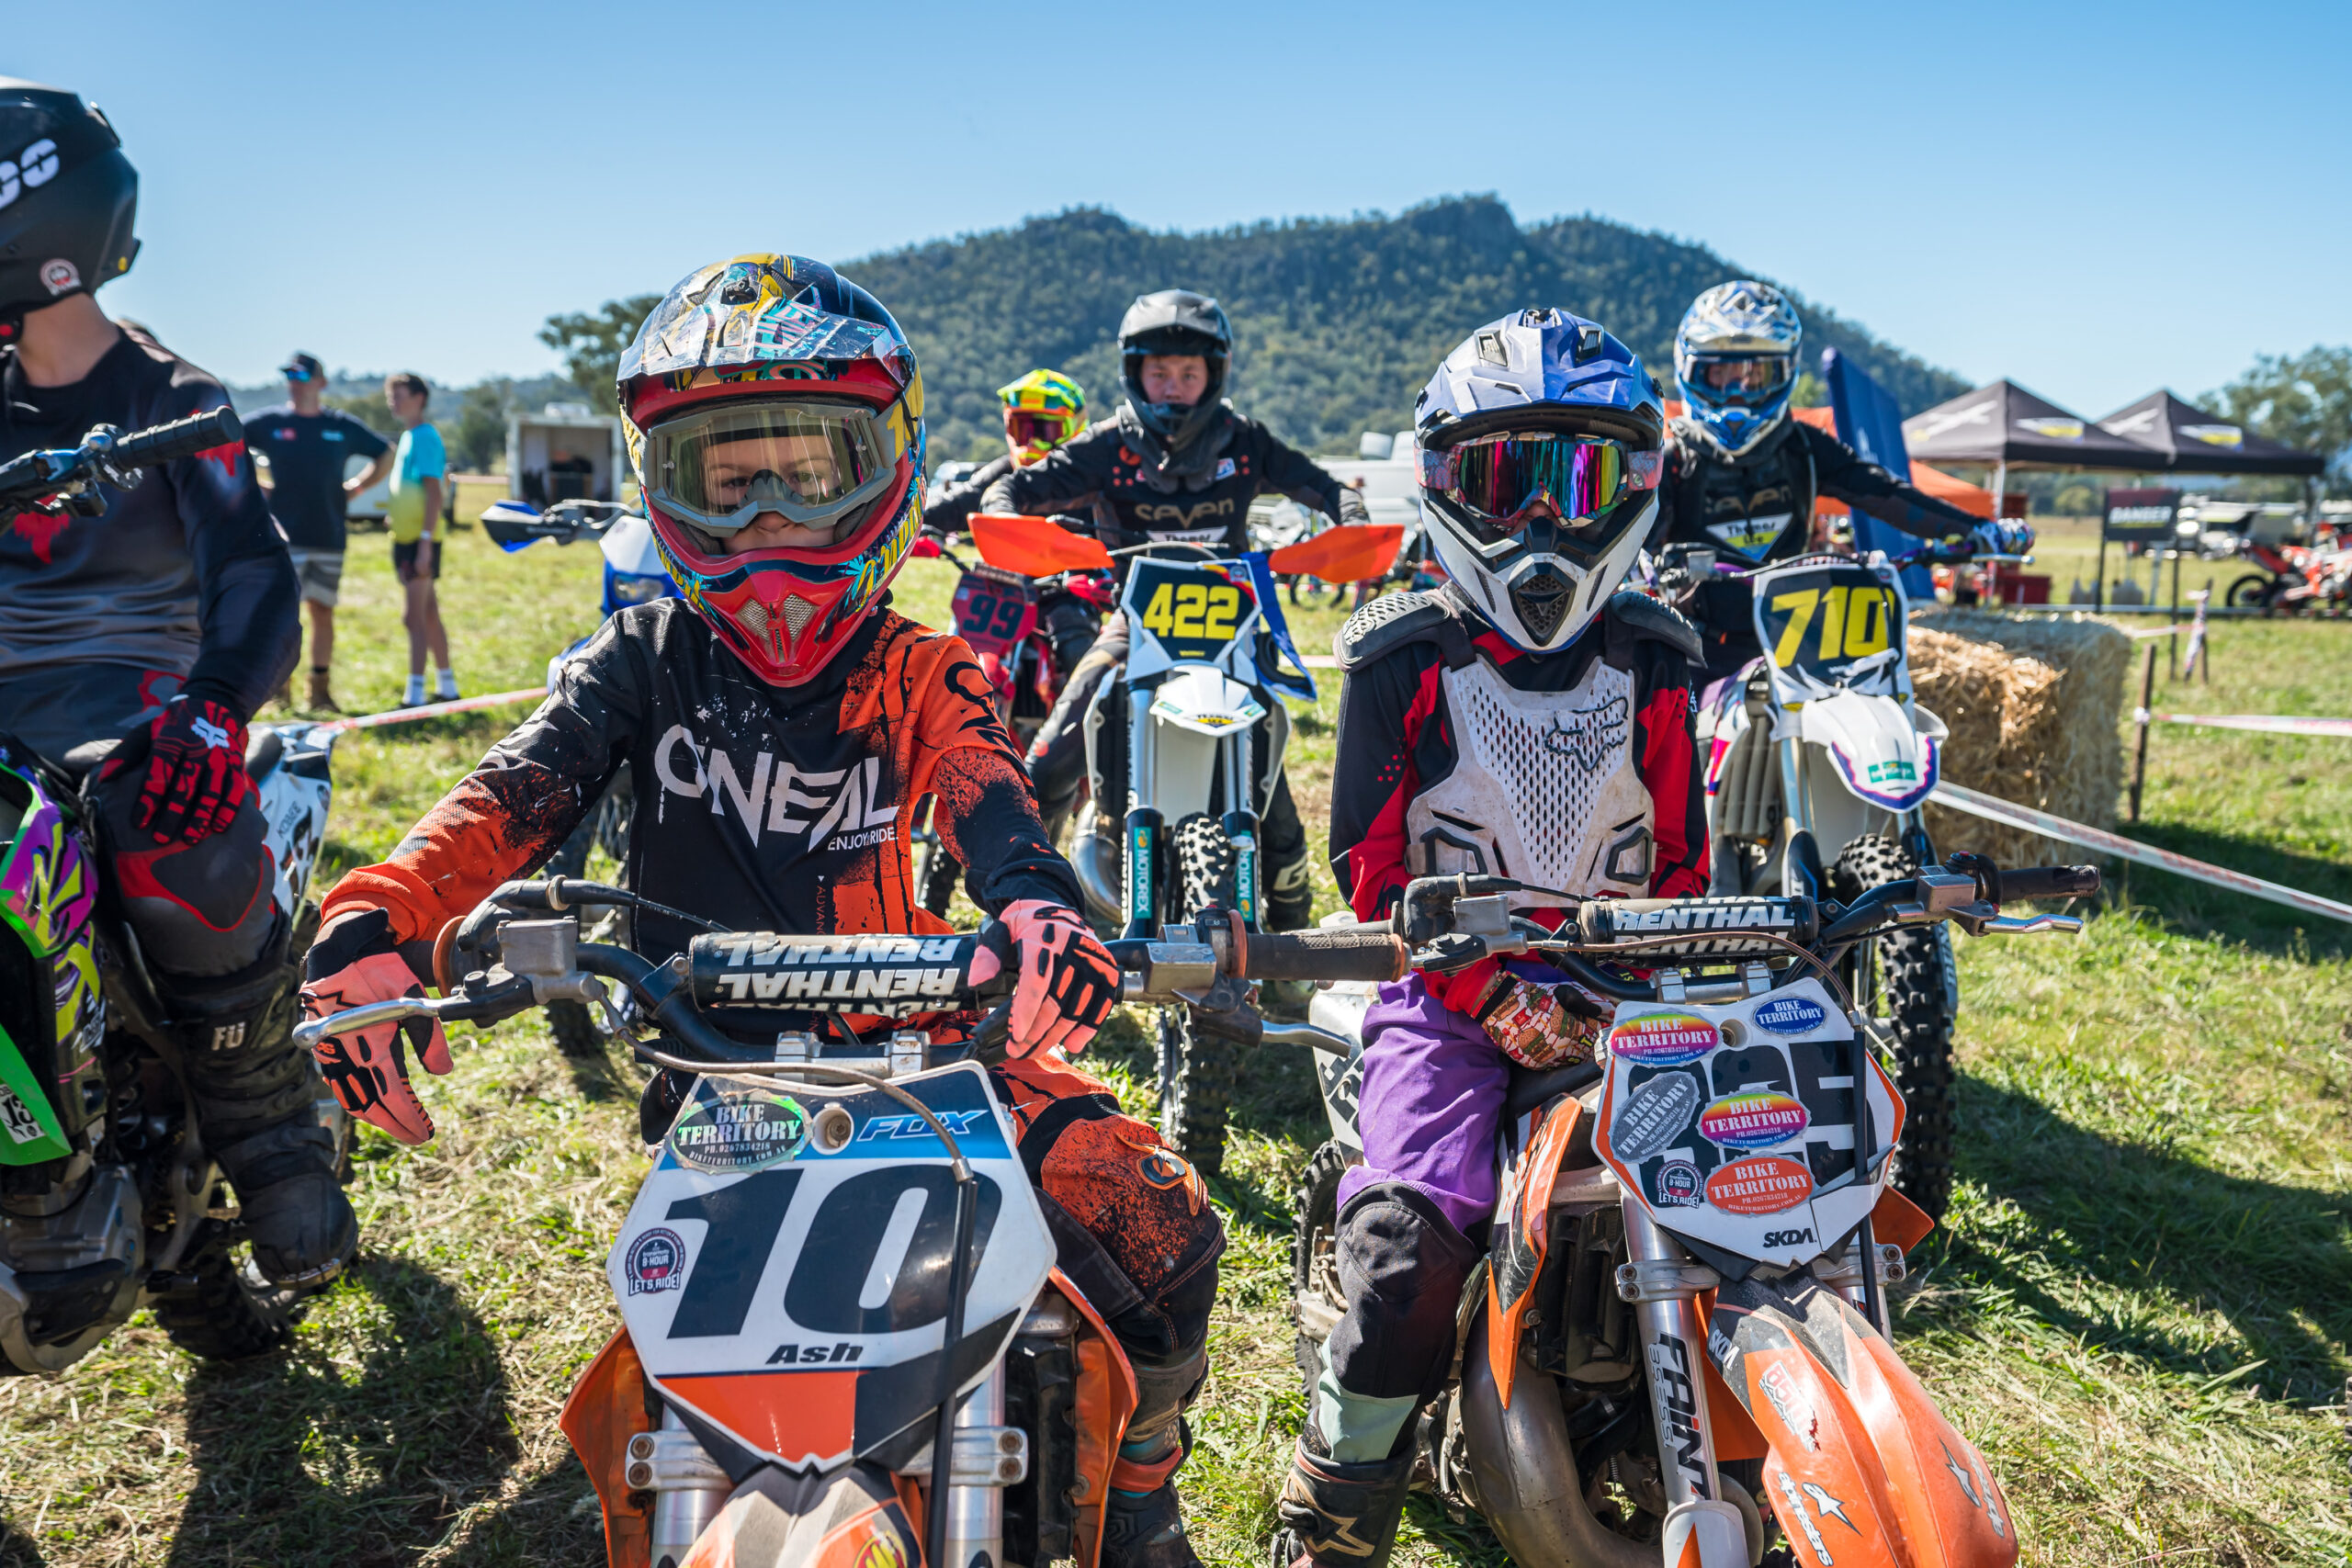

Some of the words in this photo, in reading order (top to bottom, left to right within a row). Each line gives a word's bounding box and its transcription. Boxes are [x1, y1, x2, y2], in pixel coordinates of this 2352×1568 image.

[963, 593, 1025, 640] 99
[1143, 583, 1239, 640] 422
[1771, 586, 1895, 668] 710
[1136, 849, 1149, 913] MOTOREX
[1614, 906, 1795, 931] RENTHAL
[719, 968, 961, 999] RENTHAL
[1756, 1007, 1823, 1025] TERRITORY
[1773, 999, 1802, 1012] BIKE
[1639, 1018, 1683, 1033] BIKE
[1614, 1030, 1713, 1049] TERRITORY
[716, 1104, 764, 1125] BIKE
[1618, 1078, 1689, 1155] TERRITORY
[1623, 1089, 1659, 1127] BIKE
[1728, 1098, 1772, 1115] BIKE
[678, 1120, 801, 1146] TERRITORY
[856, 1109, 989, 1142] FOX
[1705, 1110, 1801, 1134] TERRITORY
[1735, 1162, 1779, 1180] BIKE
[1668, 1179, 1691, 1188] 8-HOUR
[1711, 1175, 1809, 1199] TERRITORY
[642, 1254, 669, 1268] 8-HOUR
[663, 1164, 1002, 1339] 10
[655, 1272, 680, 1290] RIDE!
[765, 1342, 864, 1365] Ash
[1778, 1472, 1835, 1566] alpinestars
